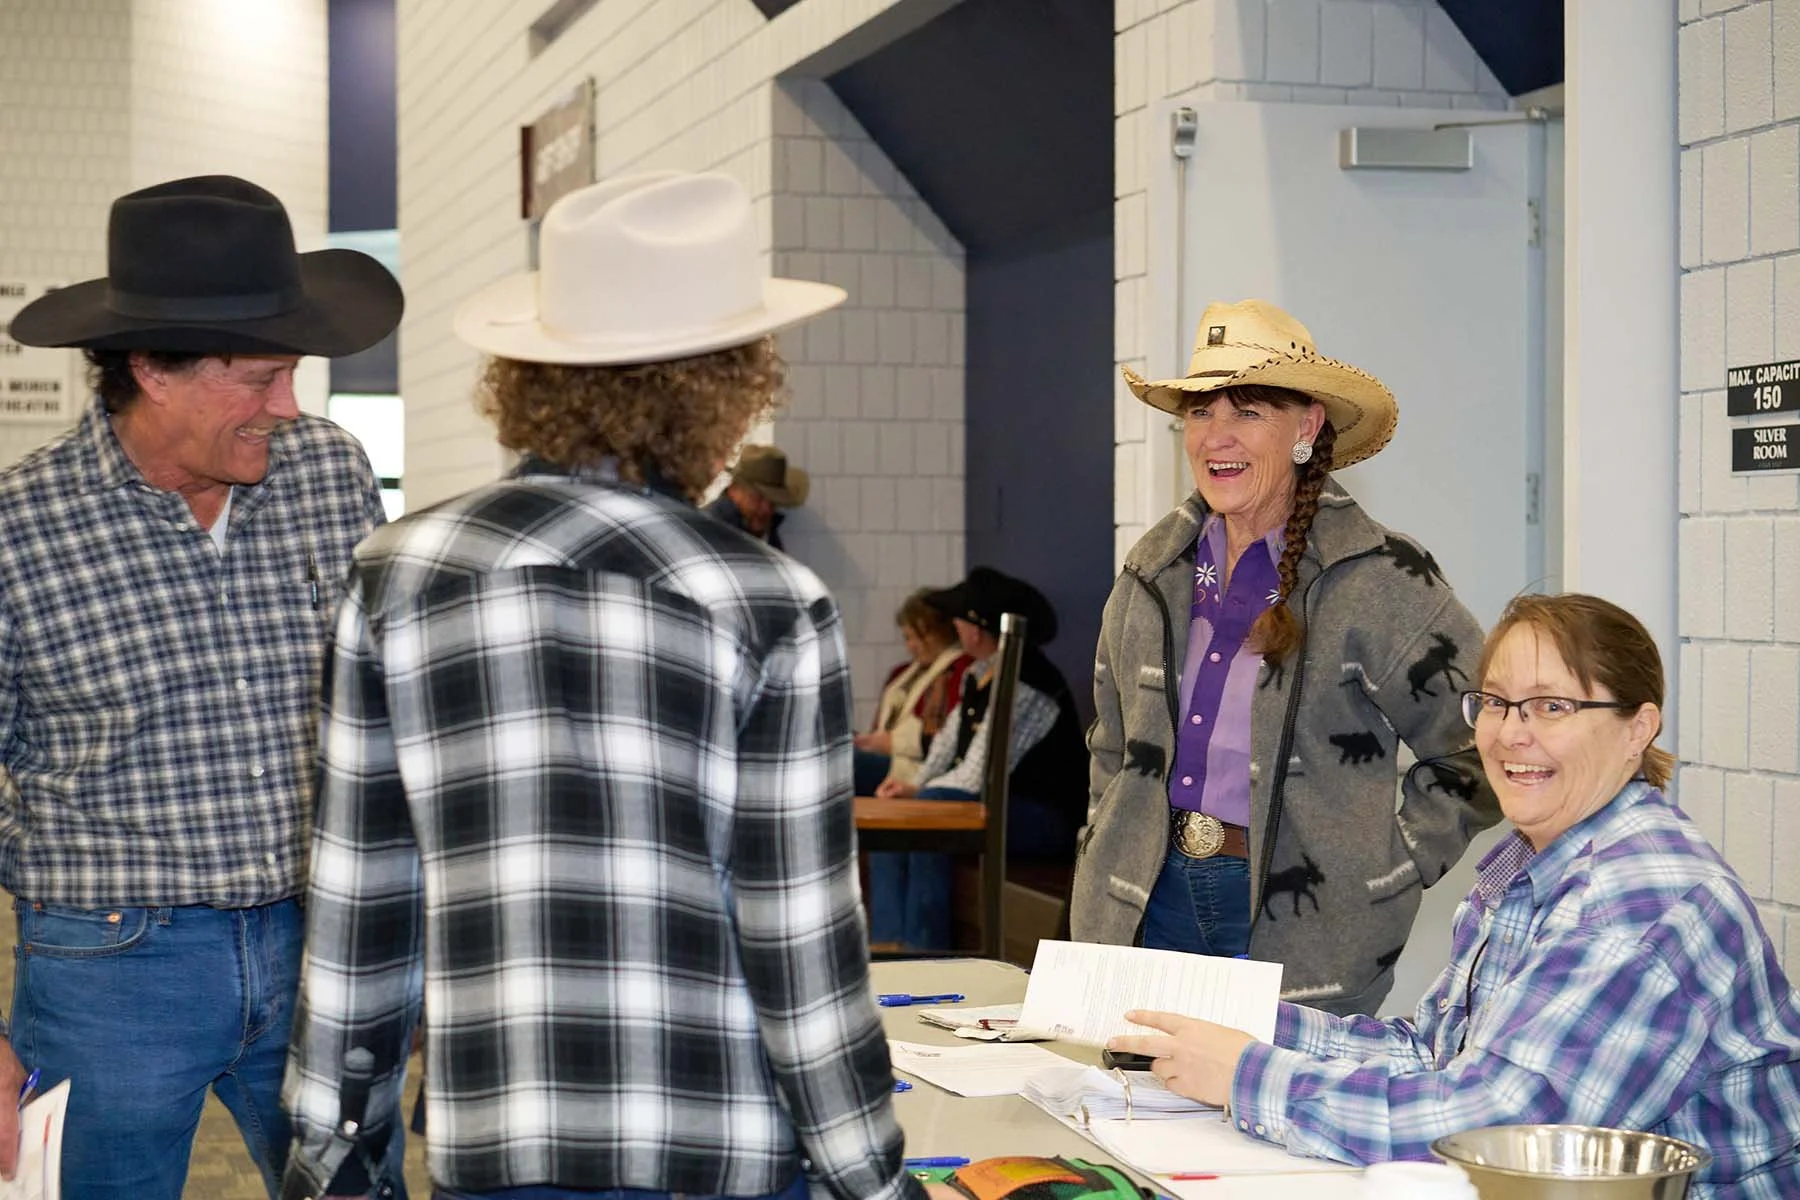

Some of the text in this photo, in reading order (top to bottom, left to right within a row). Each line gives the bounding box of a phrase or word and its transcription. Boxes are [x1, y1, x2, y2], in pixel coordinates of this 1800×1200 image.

[1728, 363, 1800, 388] MAX. CAPACIT
[1753, 385, 1782, 410] 150
[1753, 428, 1787, 443] SILVER
[1753, 444, 1788, 460] ROOM
